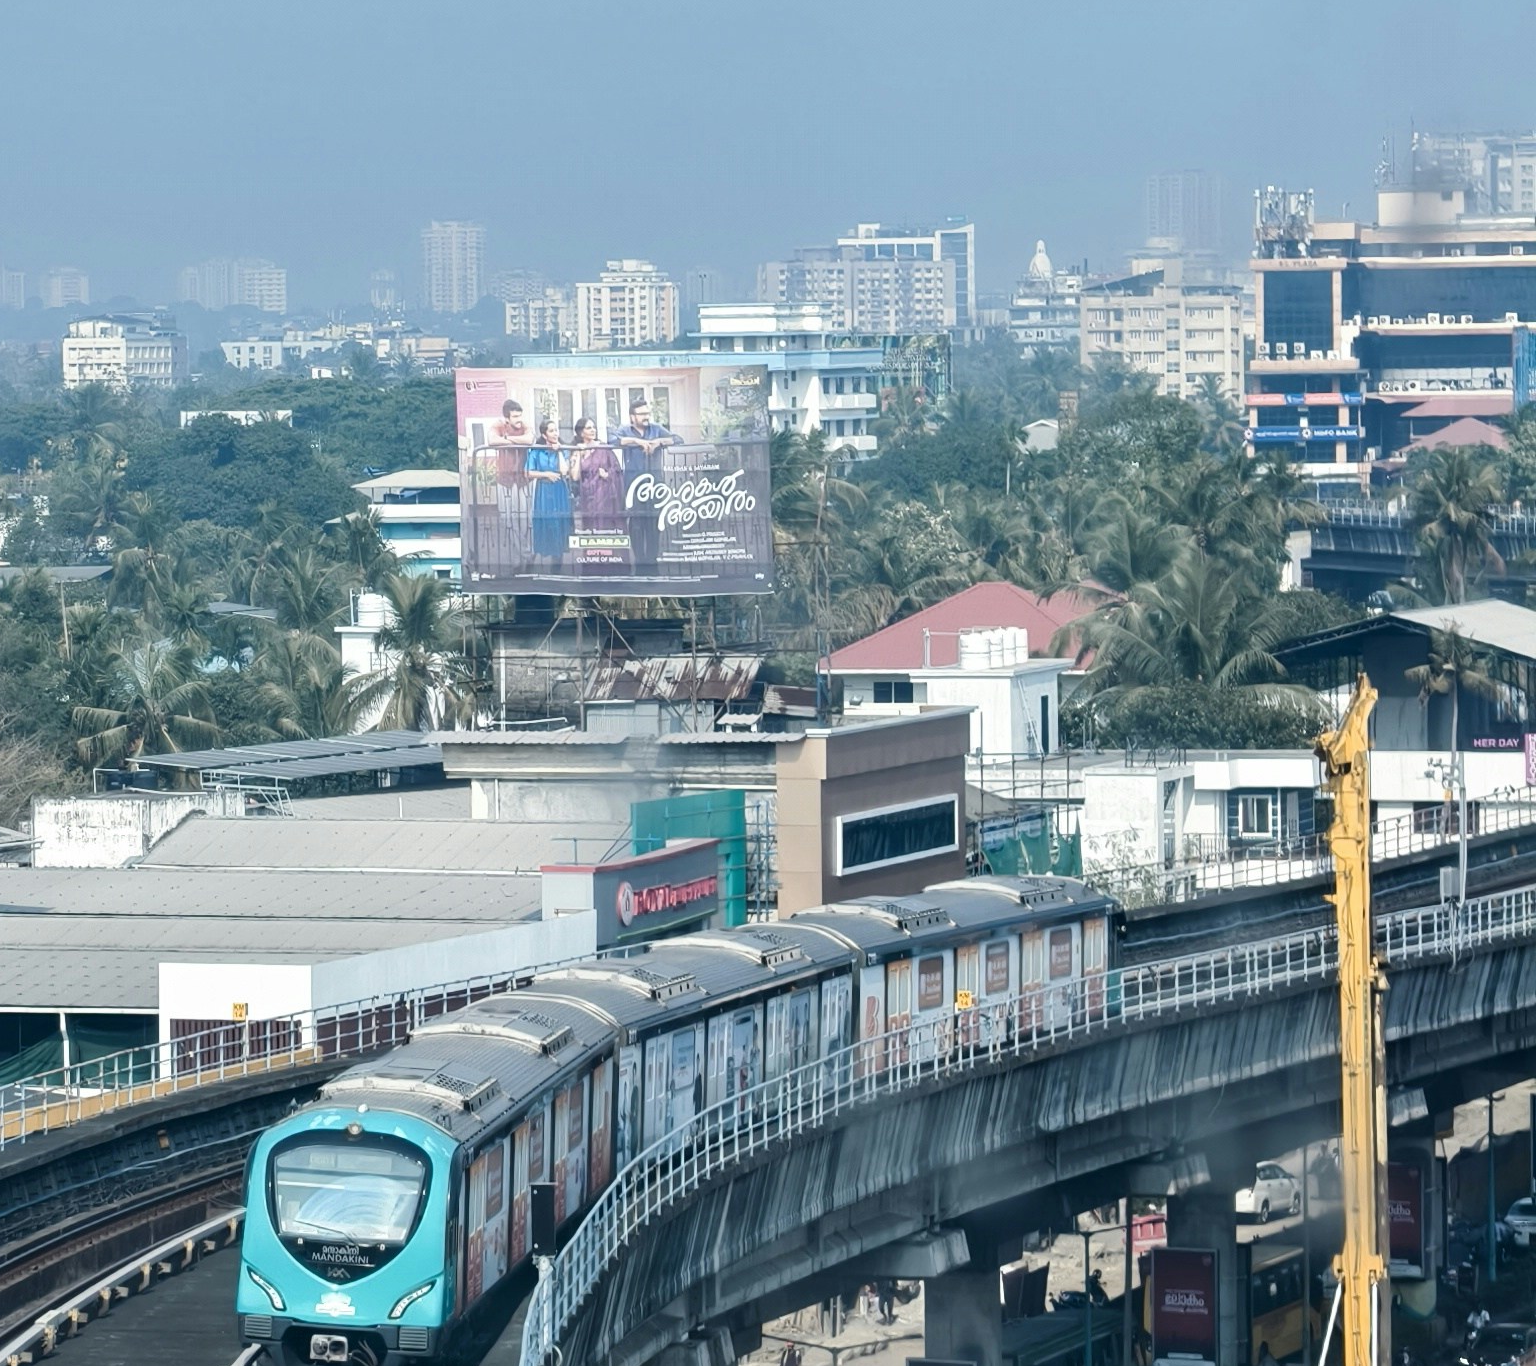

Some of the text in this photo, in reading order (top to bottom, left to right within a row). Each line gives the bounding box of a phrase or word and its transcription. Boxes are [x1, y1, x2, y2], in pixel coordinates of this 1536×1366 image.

[625, 469, 745, 509] ആശകൾ
[658, 490, 756, 532] ആയിരം
[576, 556, 600, 564] CULTURE
[608, 556, 624, 564] INDIA
[1473, 738, 1519, 747] HER DAY
[233, 1003, 244, 1011] KM
[311, 1252, 369, 1264] MANDAKINI
